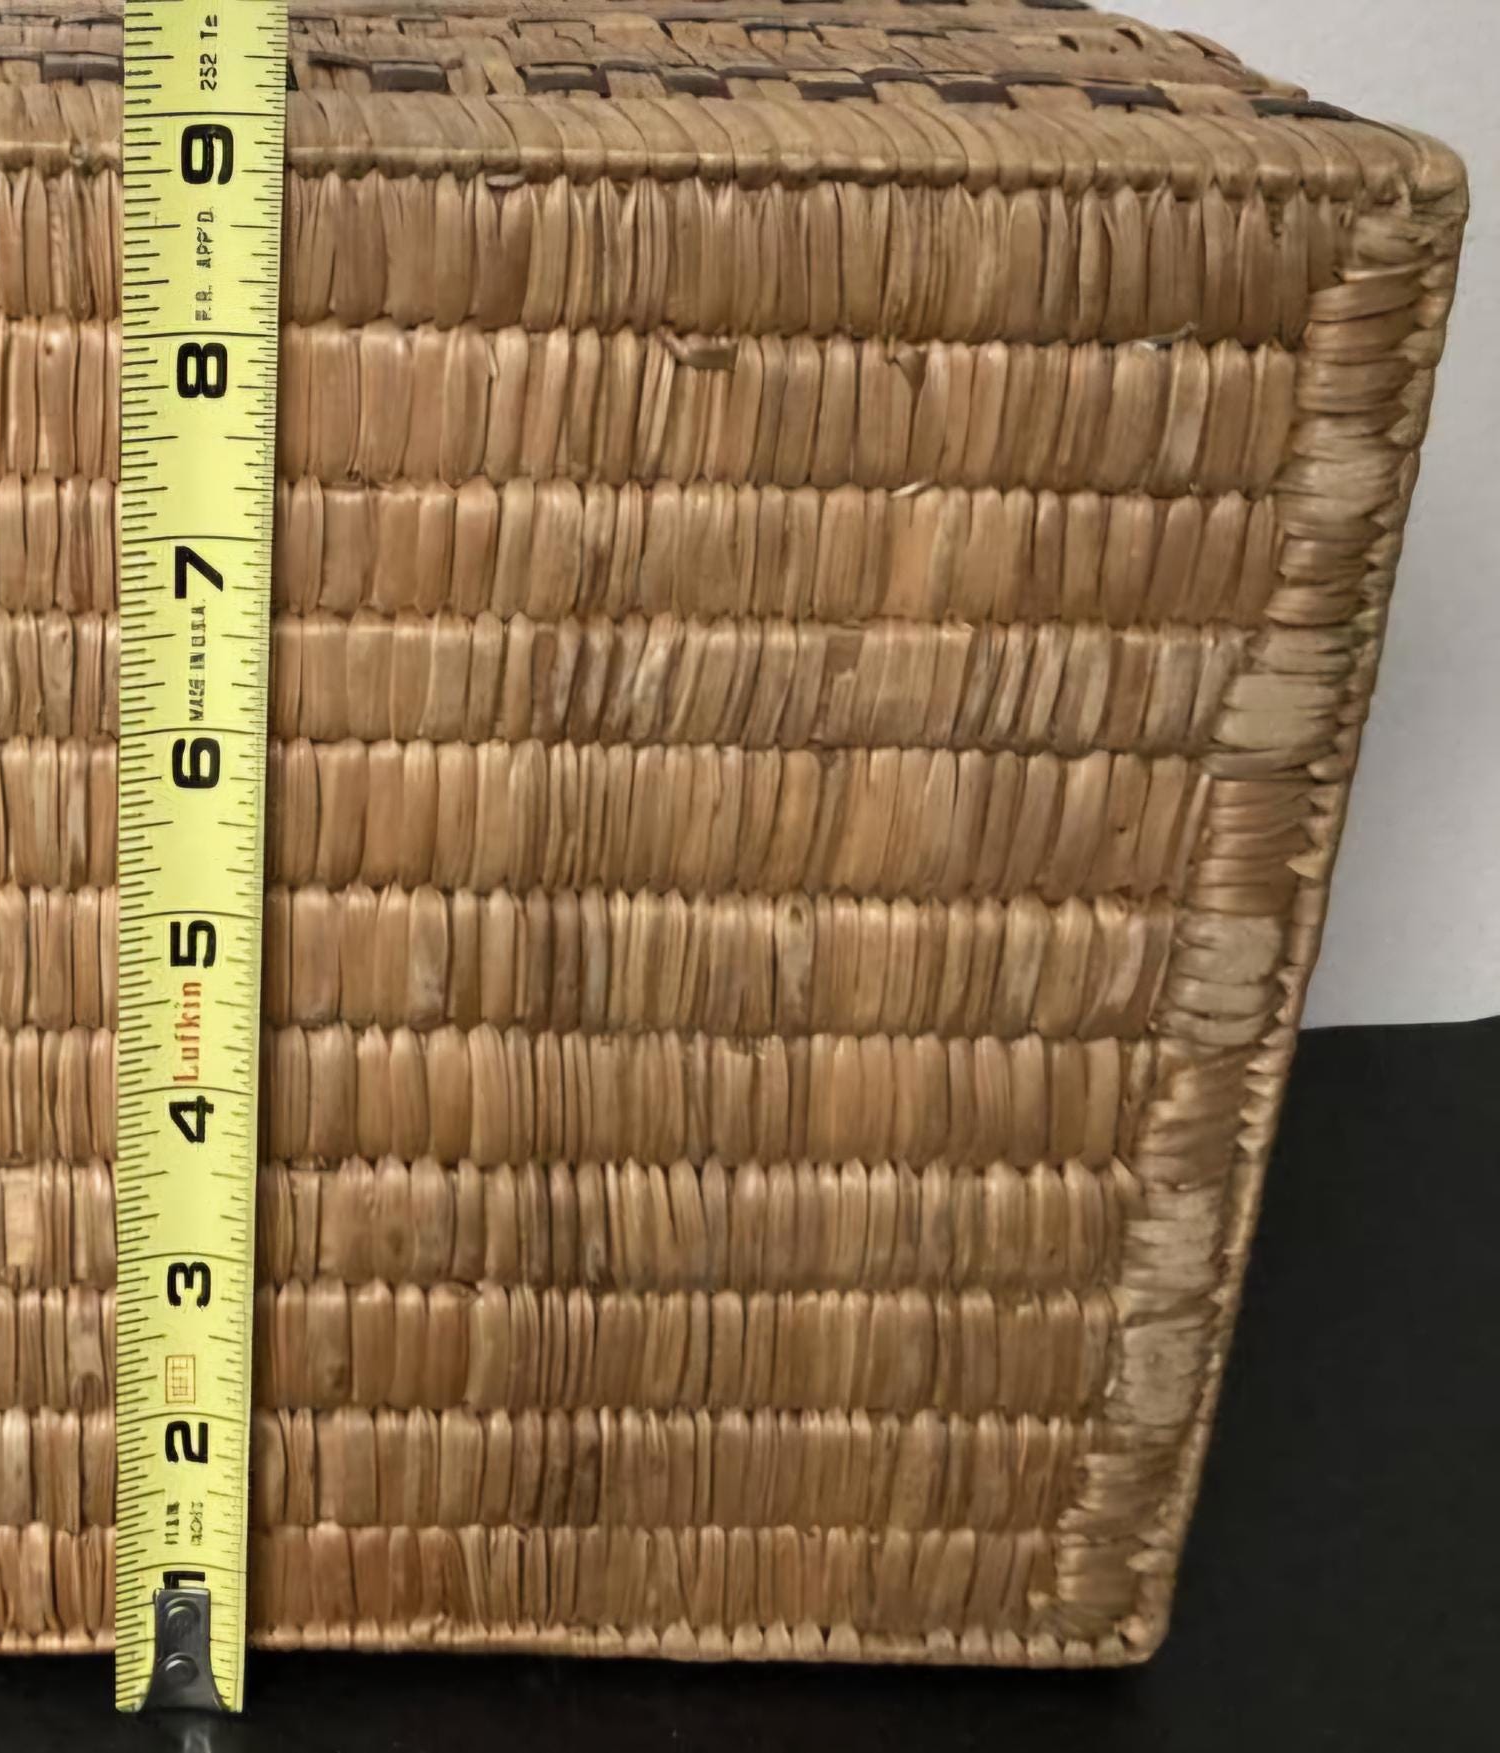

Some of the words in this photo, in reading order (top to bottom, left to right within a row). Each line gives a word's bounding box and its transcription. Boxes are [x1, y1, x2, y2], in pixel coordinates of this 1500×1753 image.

[199, 53, 218, 91] 252
[181, 124, 234, 186] 9
[177, 342, 227, 398] 8
[175, 546, 224, 600] 7
[188, 652, 207, 670] IN
[172, 738, 221, 789] 6
[170, 920, 217, 969] 5
[172, 981, 202, 1083] Lufkin
[168, 1096, 215, 1143] 4
[167, 1262, 211, 1309] 3
[165, 1420, 209, 1464] 2
